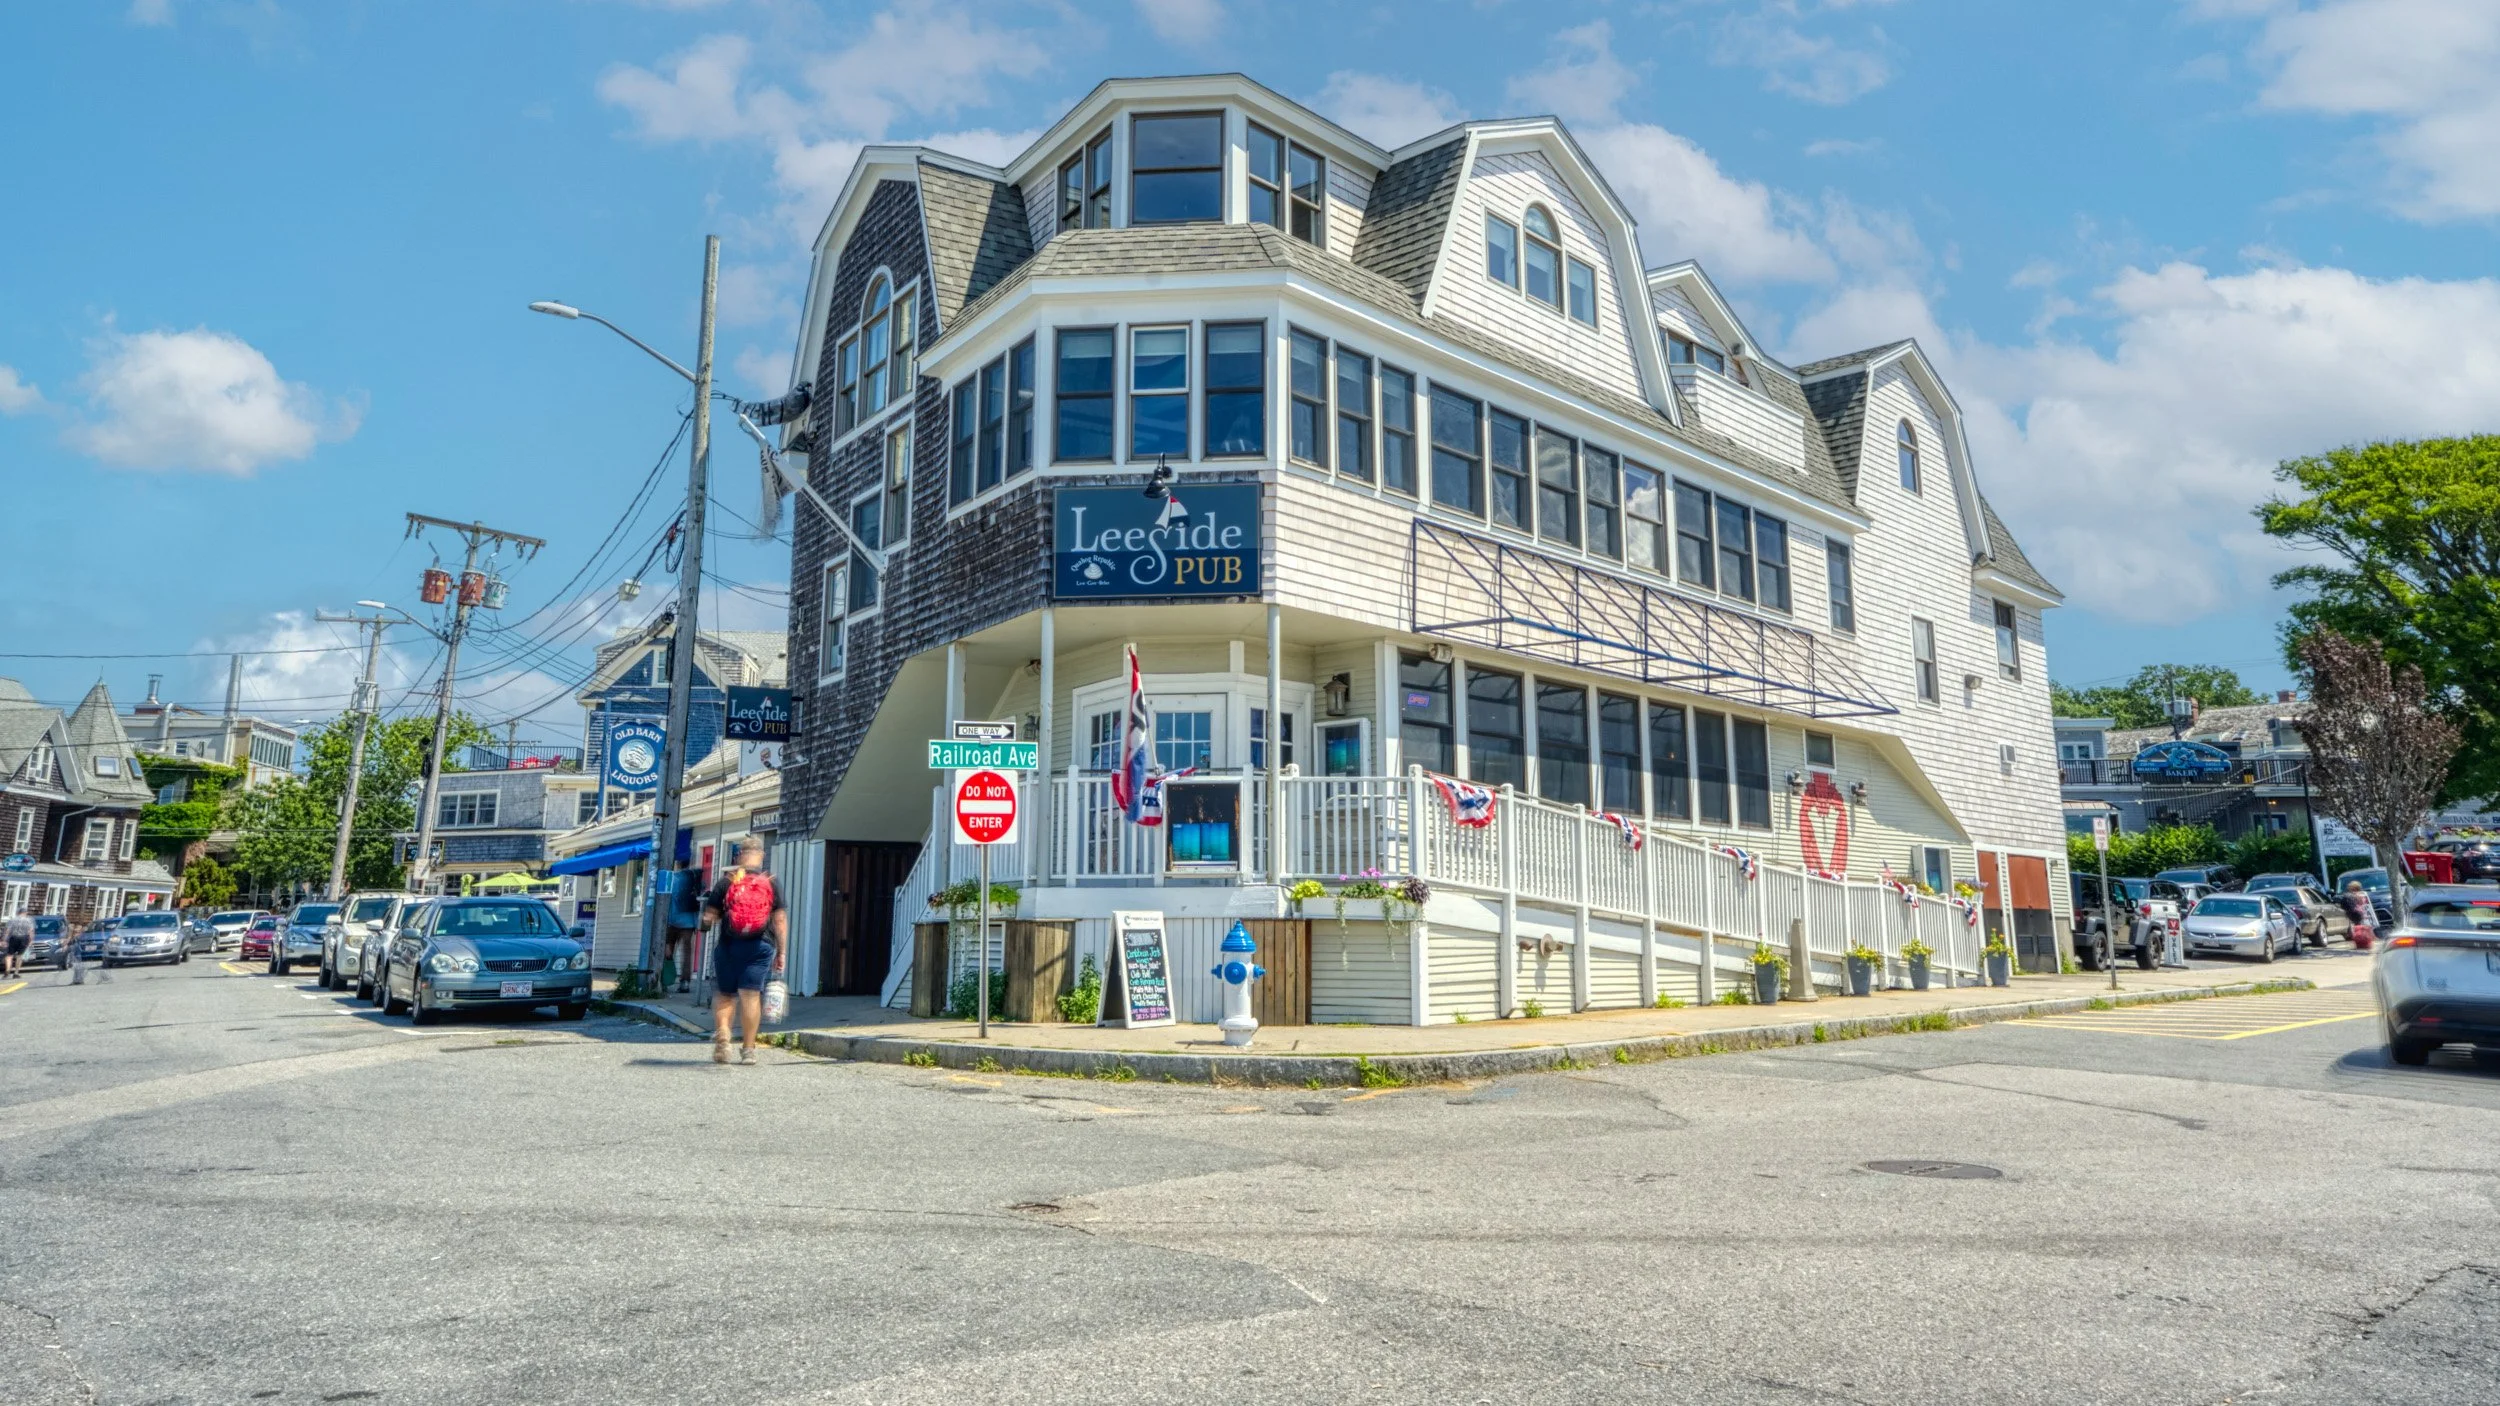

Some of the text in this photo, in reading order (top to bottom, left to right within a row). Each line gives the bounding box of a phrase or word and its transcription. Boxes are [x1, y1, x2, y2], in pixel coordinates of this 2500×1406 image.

[1070, 506, 1243, 585] Leeside
[1070, 554, 1117, 572] Quahog Republic
[1174, 556, 1243, 585] PUB
[730, 699, 788, 733] Leeside
[614, 727, 663, 743] OLD BARN
[764, 722, 787, 735] PUB
[961, 727, 1000, 736] ONE WAY
[930, 744, 1037, 766] Railroad Ave
[611, 769, 659, 785] LIQUORS
[2165, 769, 2199, 777] BAKERY
[965, 785, 1008, 798] DO NOT
[968, 816, 1003, 829] ENTER
[2453, 816, 2477, 824] BANK
